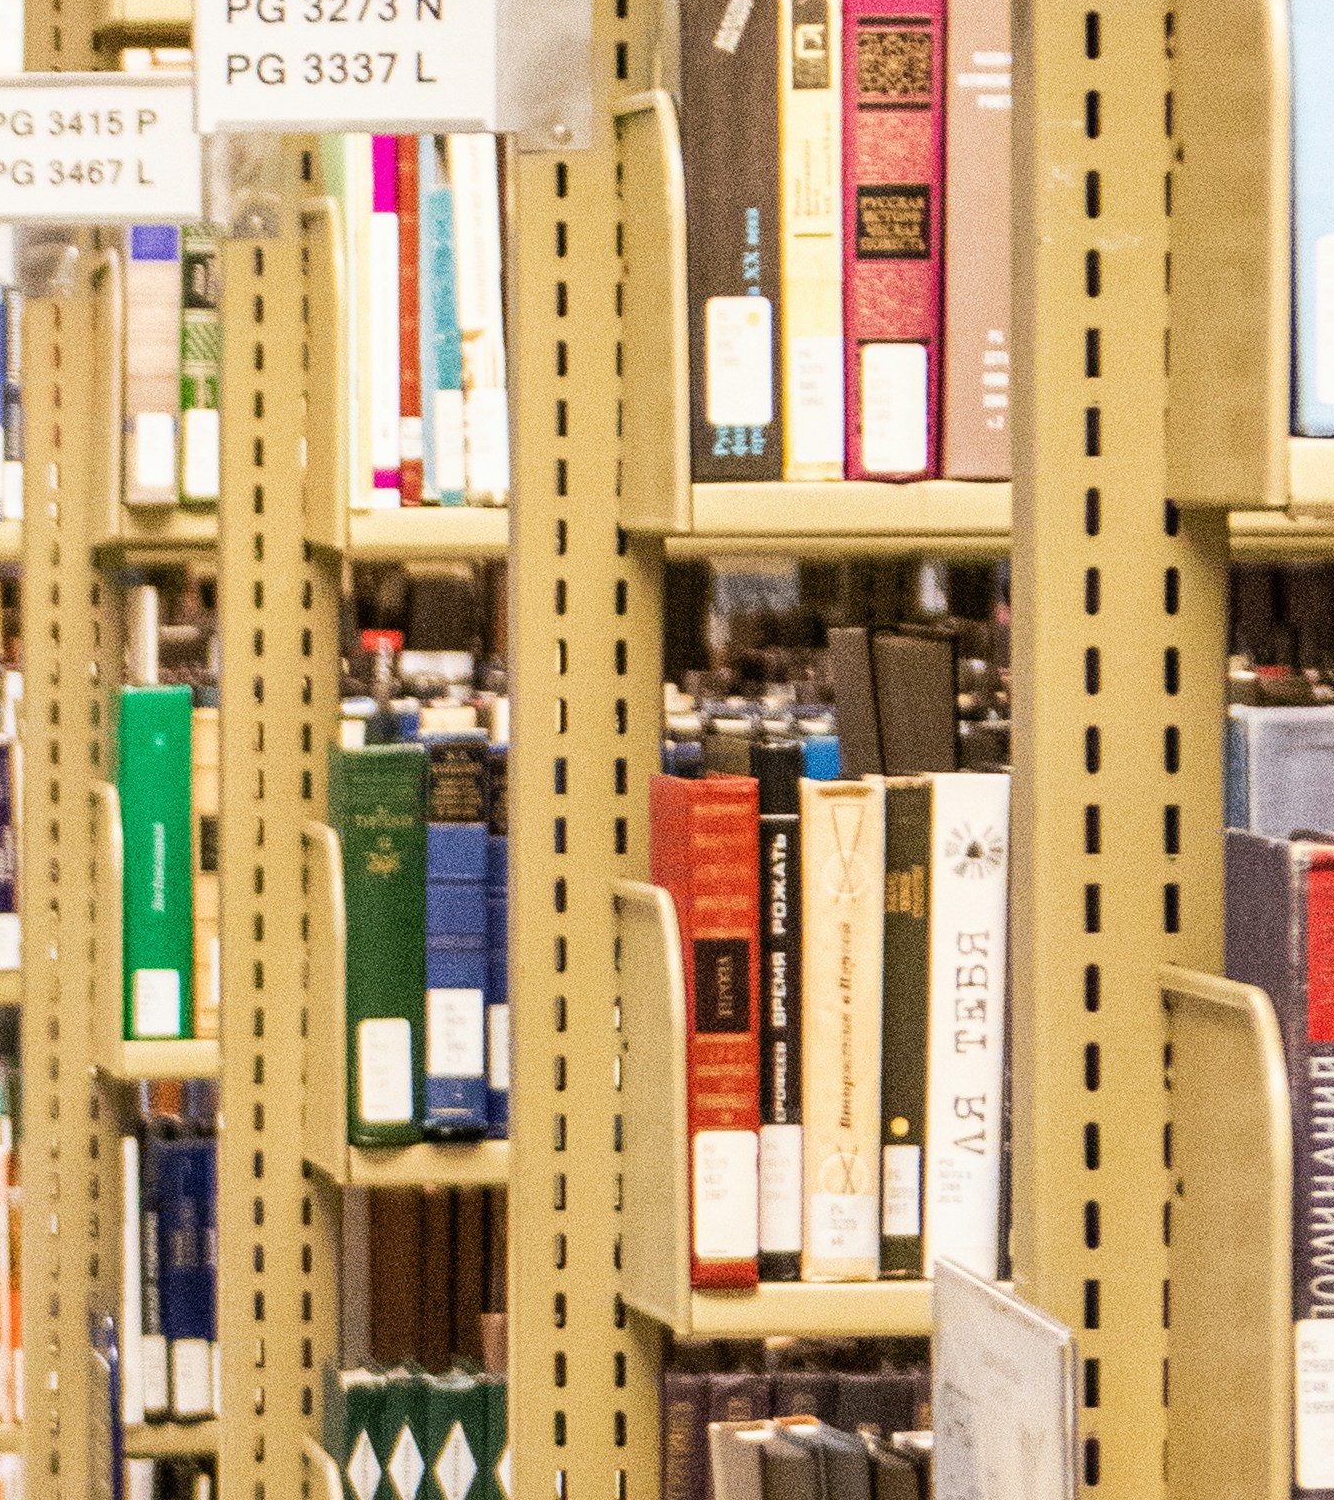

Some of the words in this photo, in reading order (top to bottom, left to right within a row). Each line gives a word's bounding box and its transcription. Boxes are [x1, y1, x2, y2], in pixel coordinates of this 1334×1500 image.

[225, 52, 287, 87] PG
[304, 51, 398, 86] 3337
[414, 52, 436, 85] L
[49, 110, 124, 137] 3415
[136, 109, 158, 134] P
[50, 159, 123, 186] 3467
[136, 162, 152, 186] L
[770, 833, 789, 936] РОЖАТЬ
[771, 951, 789, 1029] ВРЕМЯ
[952, 929, 990, 1056] ТЕБЯ
